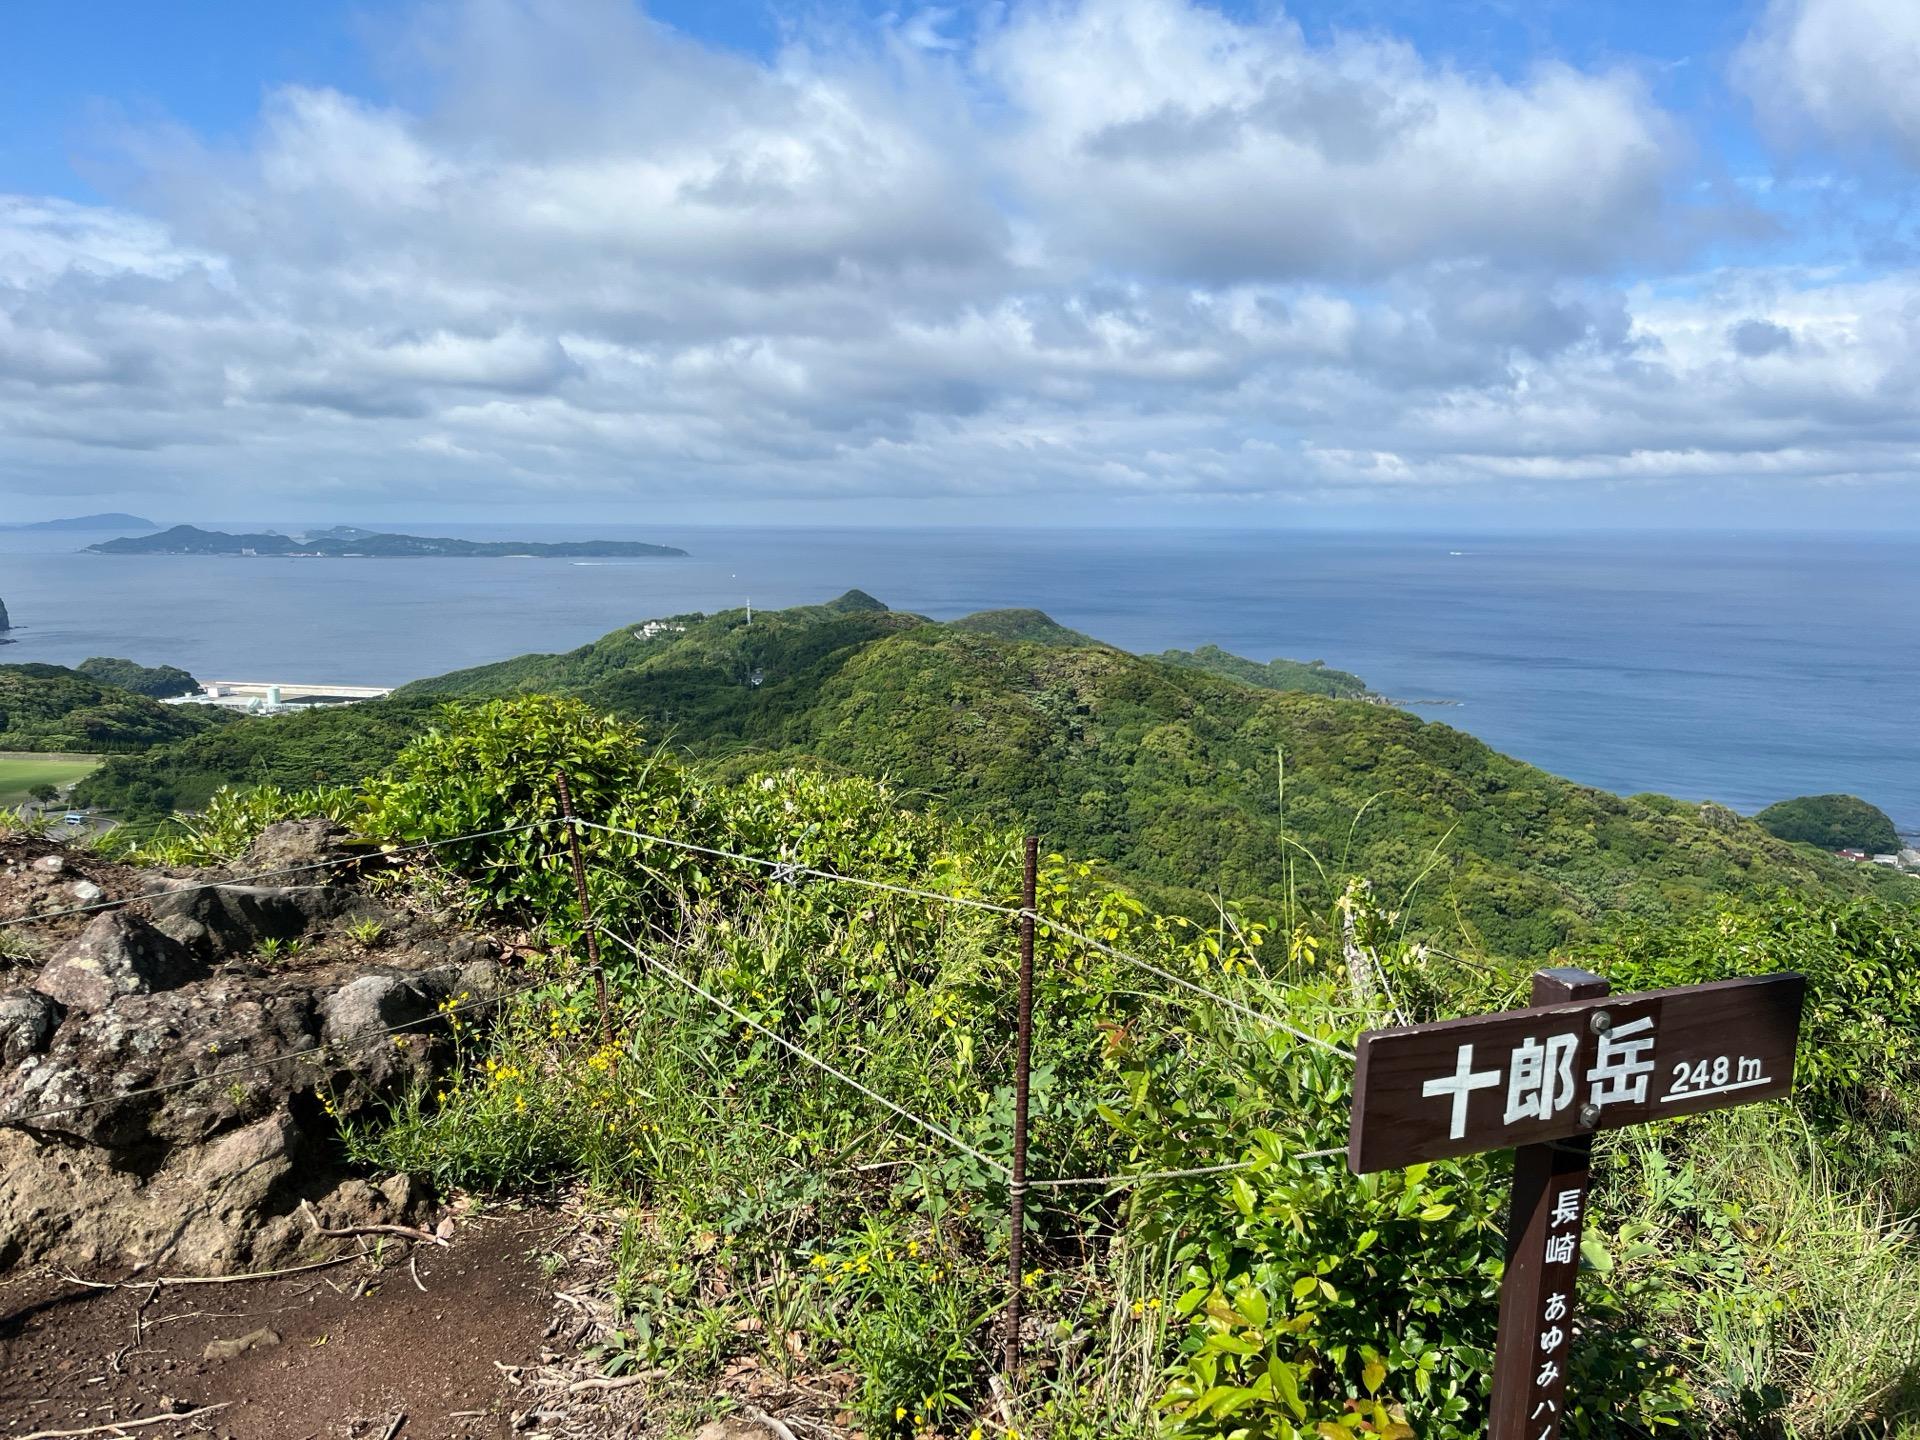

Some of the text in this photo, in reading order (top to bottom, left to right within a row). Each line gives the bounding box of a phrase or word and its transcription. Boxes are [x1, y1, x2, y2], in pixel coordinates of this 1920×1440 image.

[1422, 1016, 1655, 1140] 十郎岳
[1670, 1056, 1729, 1093] 248
[1545, 1188, 1581, 1264] 長崎
